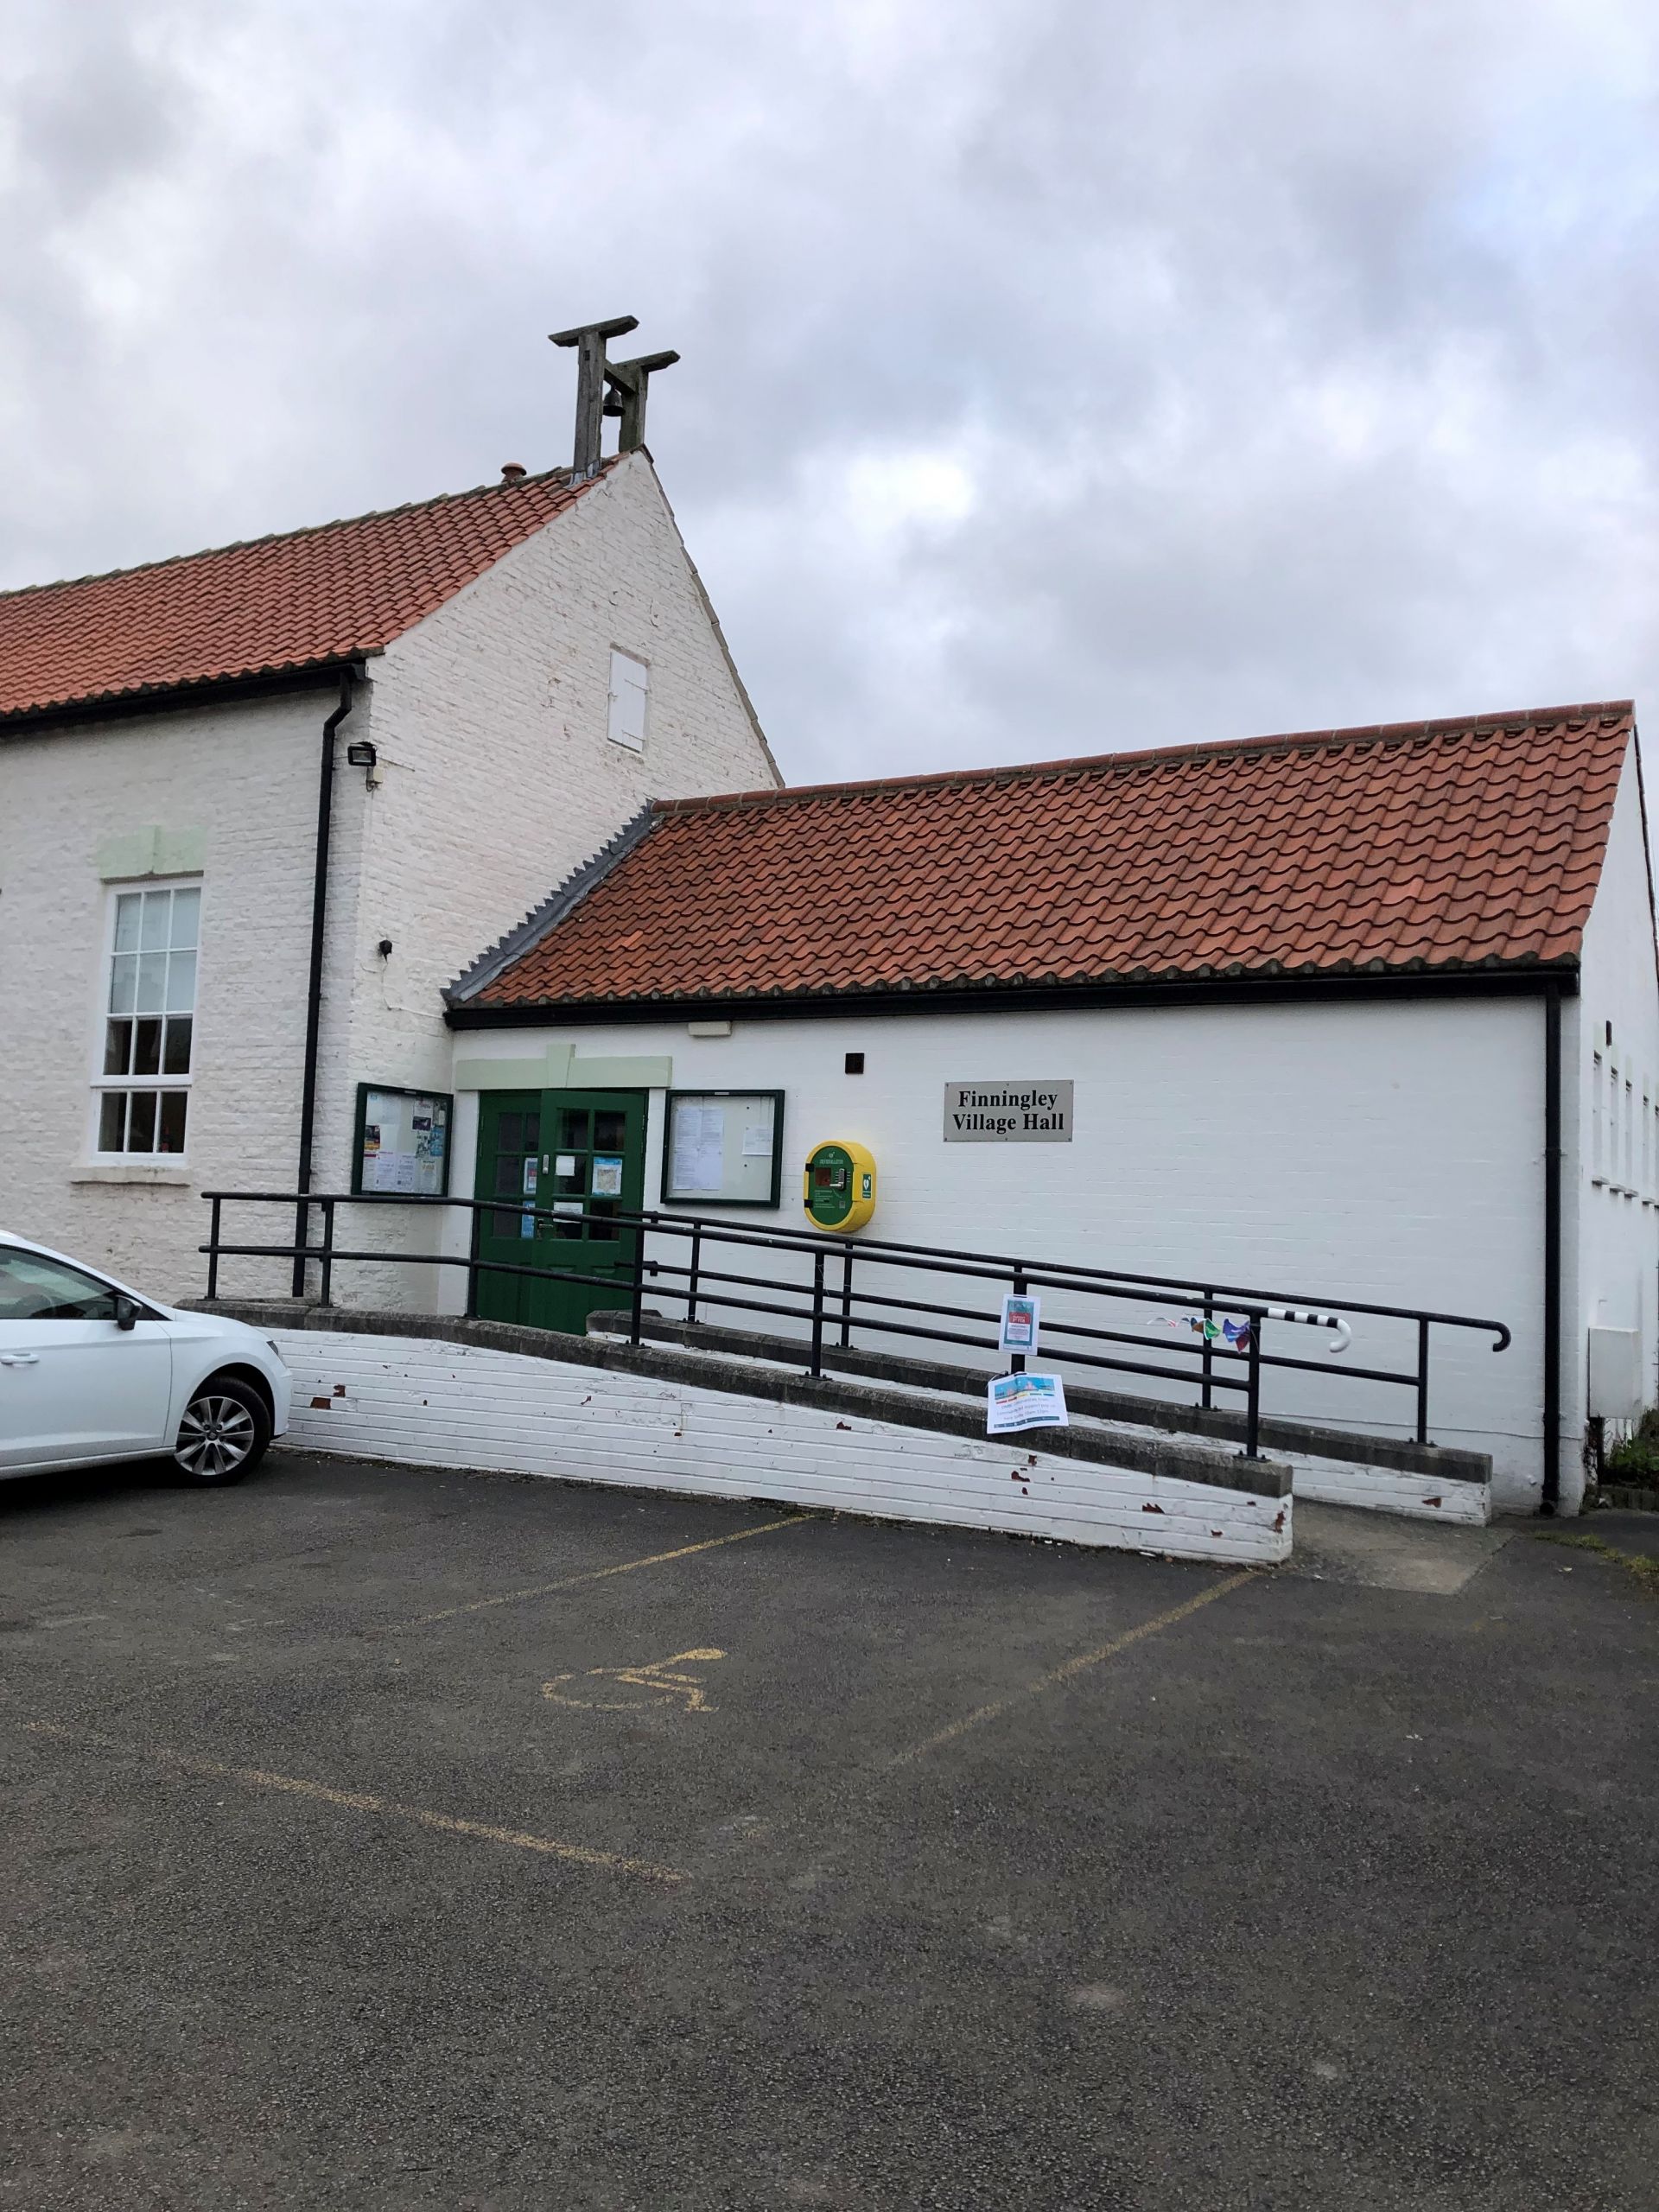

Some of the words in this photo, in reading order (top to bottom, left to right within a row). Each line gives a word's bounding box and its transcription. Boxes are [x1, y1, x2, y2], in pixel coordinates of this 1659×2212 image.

[958, 1090, 1058, 1111] Finningley
[953, 1114, 1017, 1135] Village
[1023, 1113, 1064, 1130] Hall
